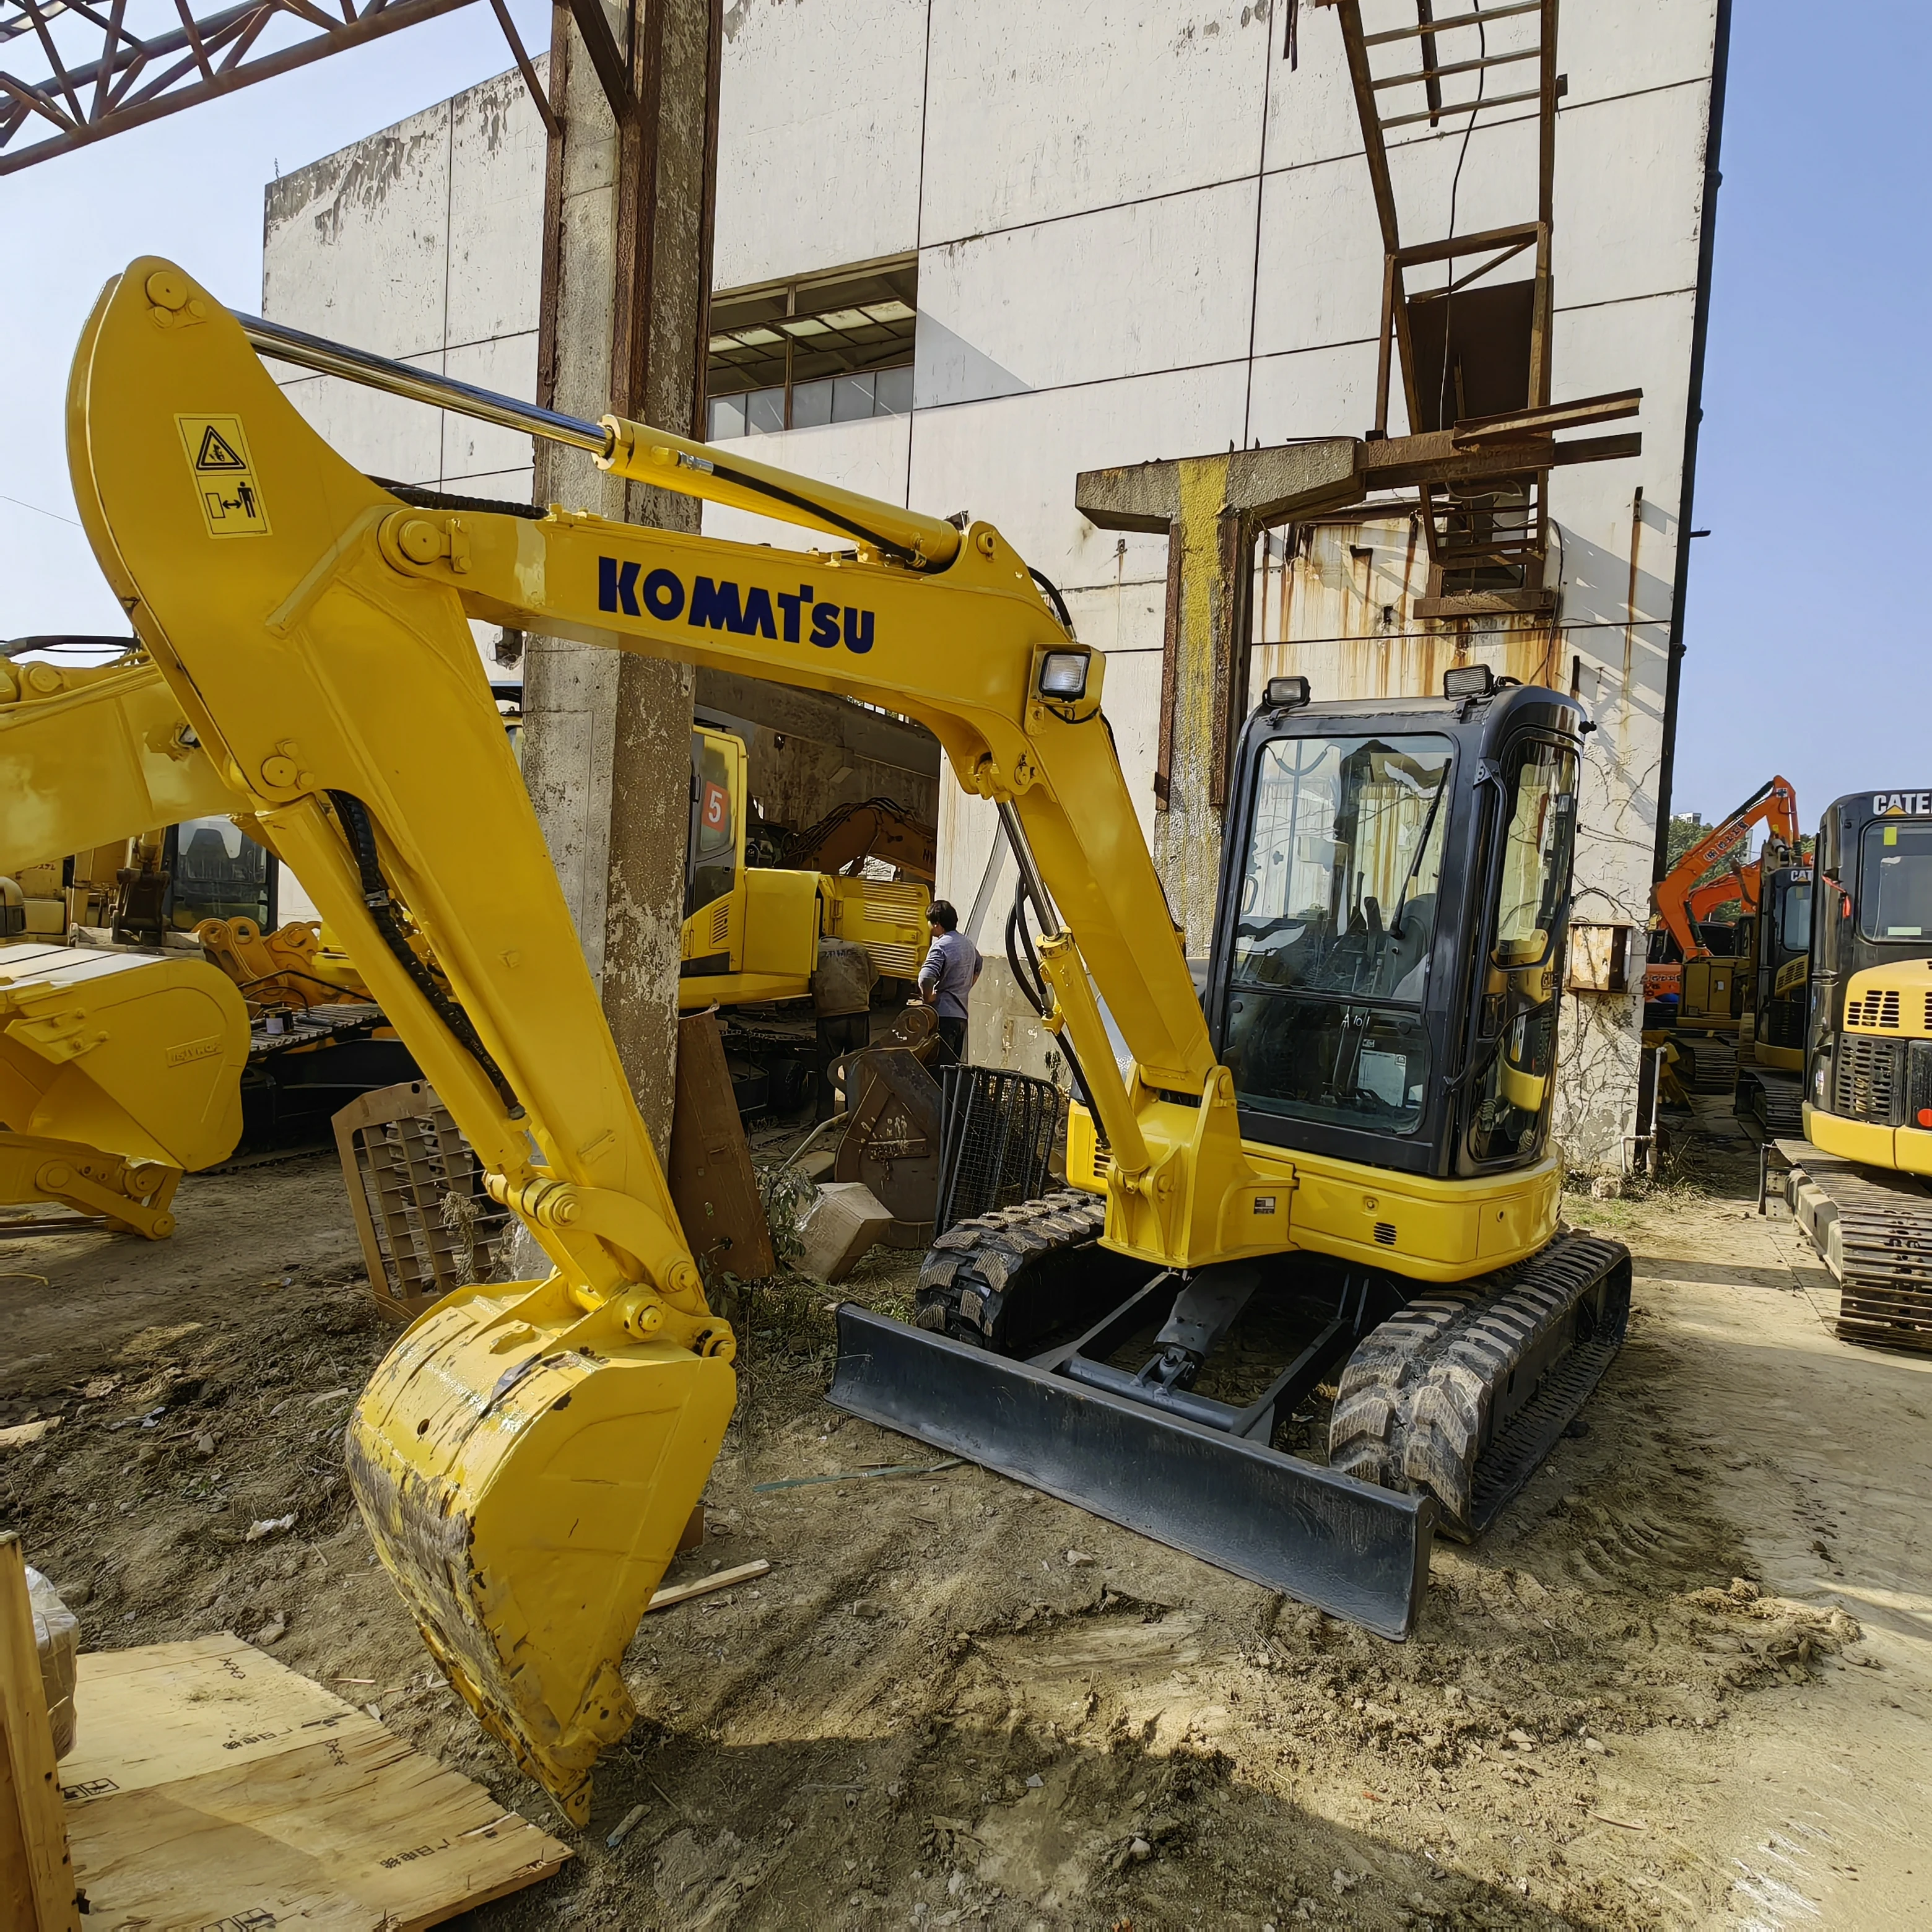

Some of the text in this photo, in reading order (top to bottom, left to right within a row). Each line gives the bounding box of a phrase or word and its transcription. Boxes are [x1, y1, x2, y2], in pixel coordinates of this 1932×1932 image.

[598, 555, 875, 654] KOMATSU
[708, 790, 723, 823] 5
[1873, 793, 1932, 816] CATE
